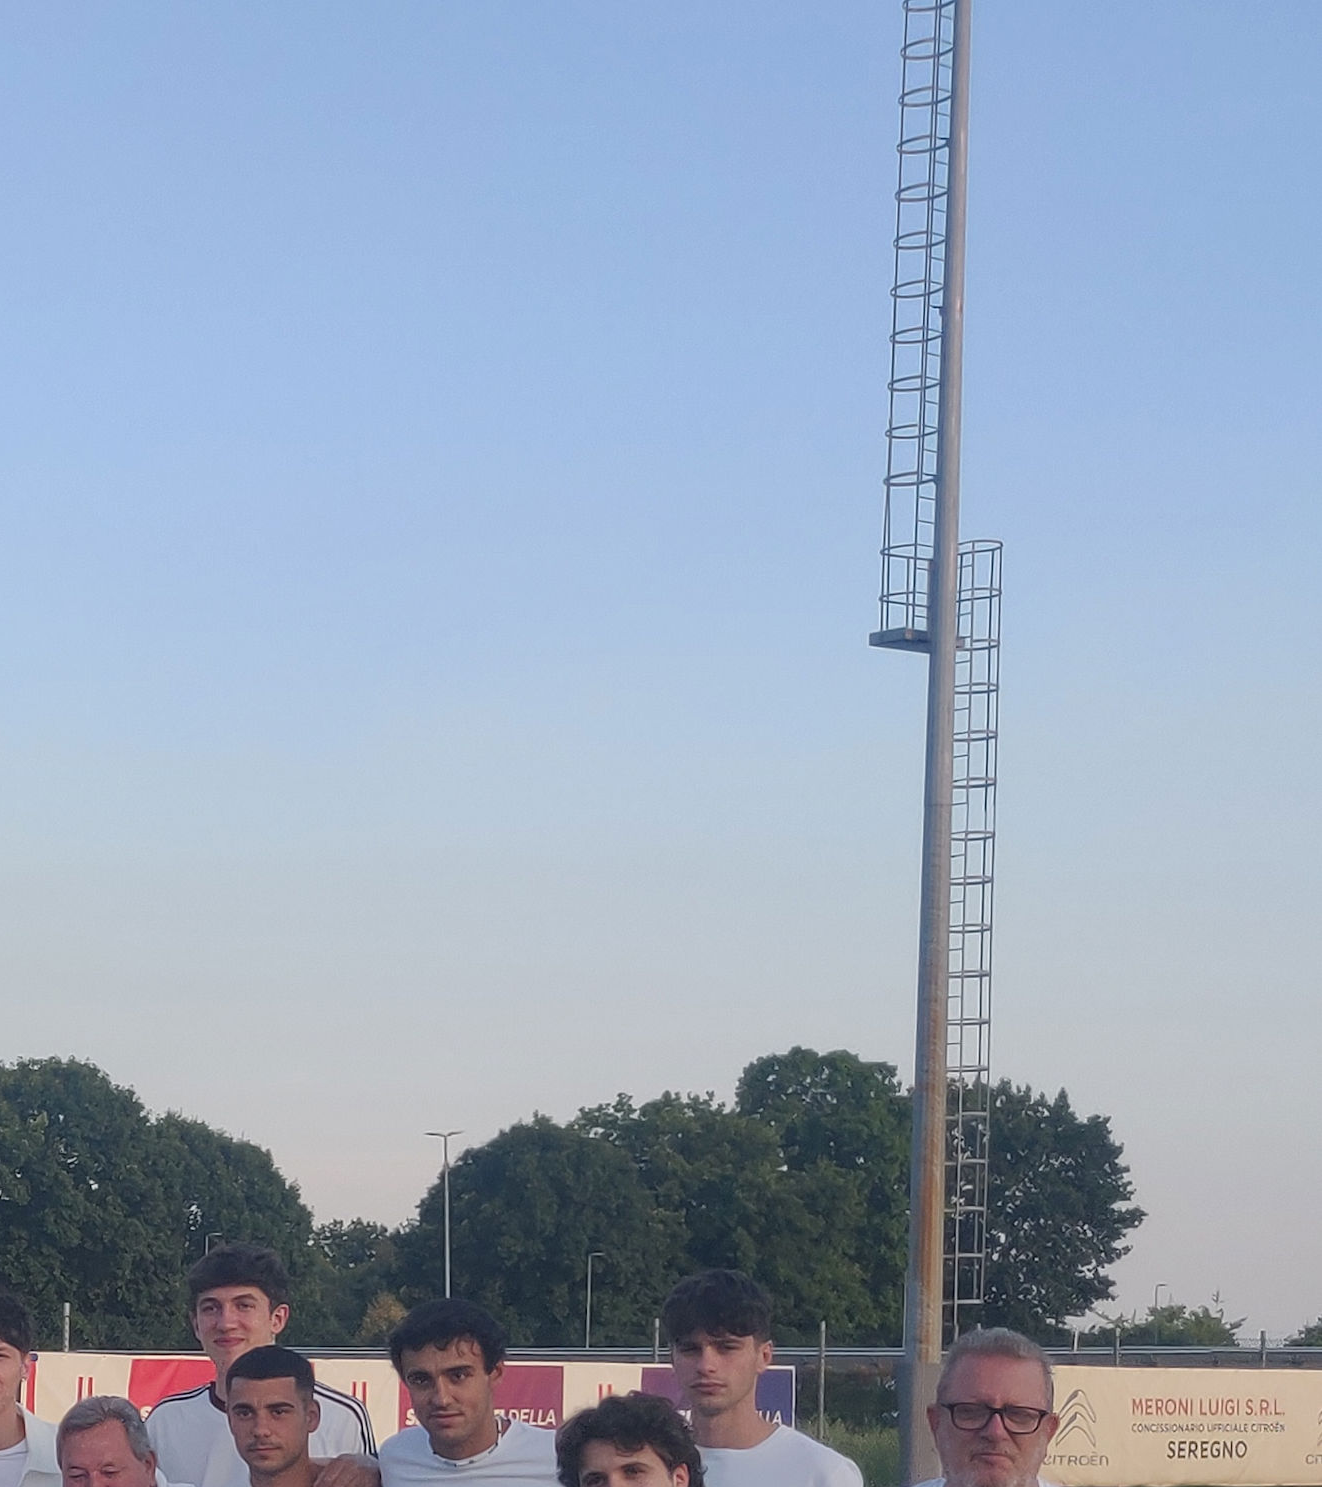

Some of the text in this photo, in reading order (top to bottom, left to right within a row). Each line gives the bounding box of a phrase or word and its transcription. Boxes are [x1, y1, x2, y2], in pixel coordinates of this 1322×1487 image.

[1132, 1398, 1285, 1416] MERONI LUIGI S.R.L.
[508, 1409, 556, 1426] DELLA
[1131, 1423, 1205, 1433] CONCESSIONARIO
[1207, 1423, 1248, 1433] UFFICIALE
[1167, 1441, 1248, 1459] SEREGNO
